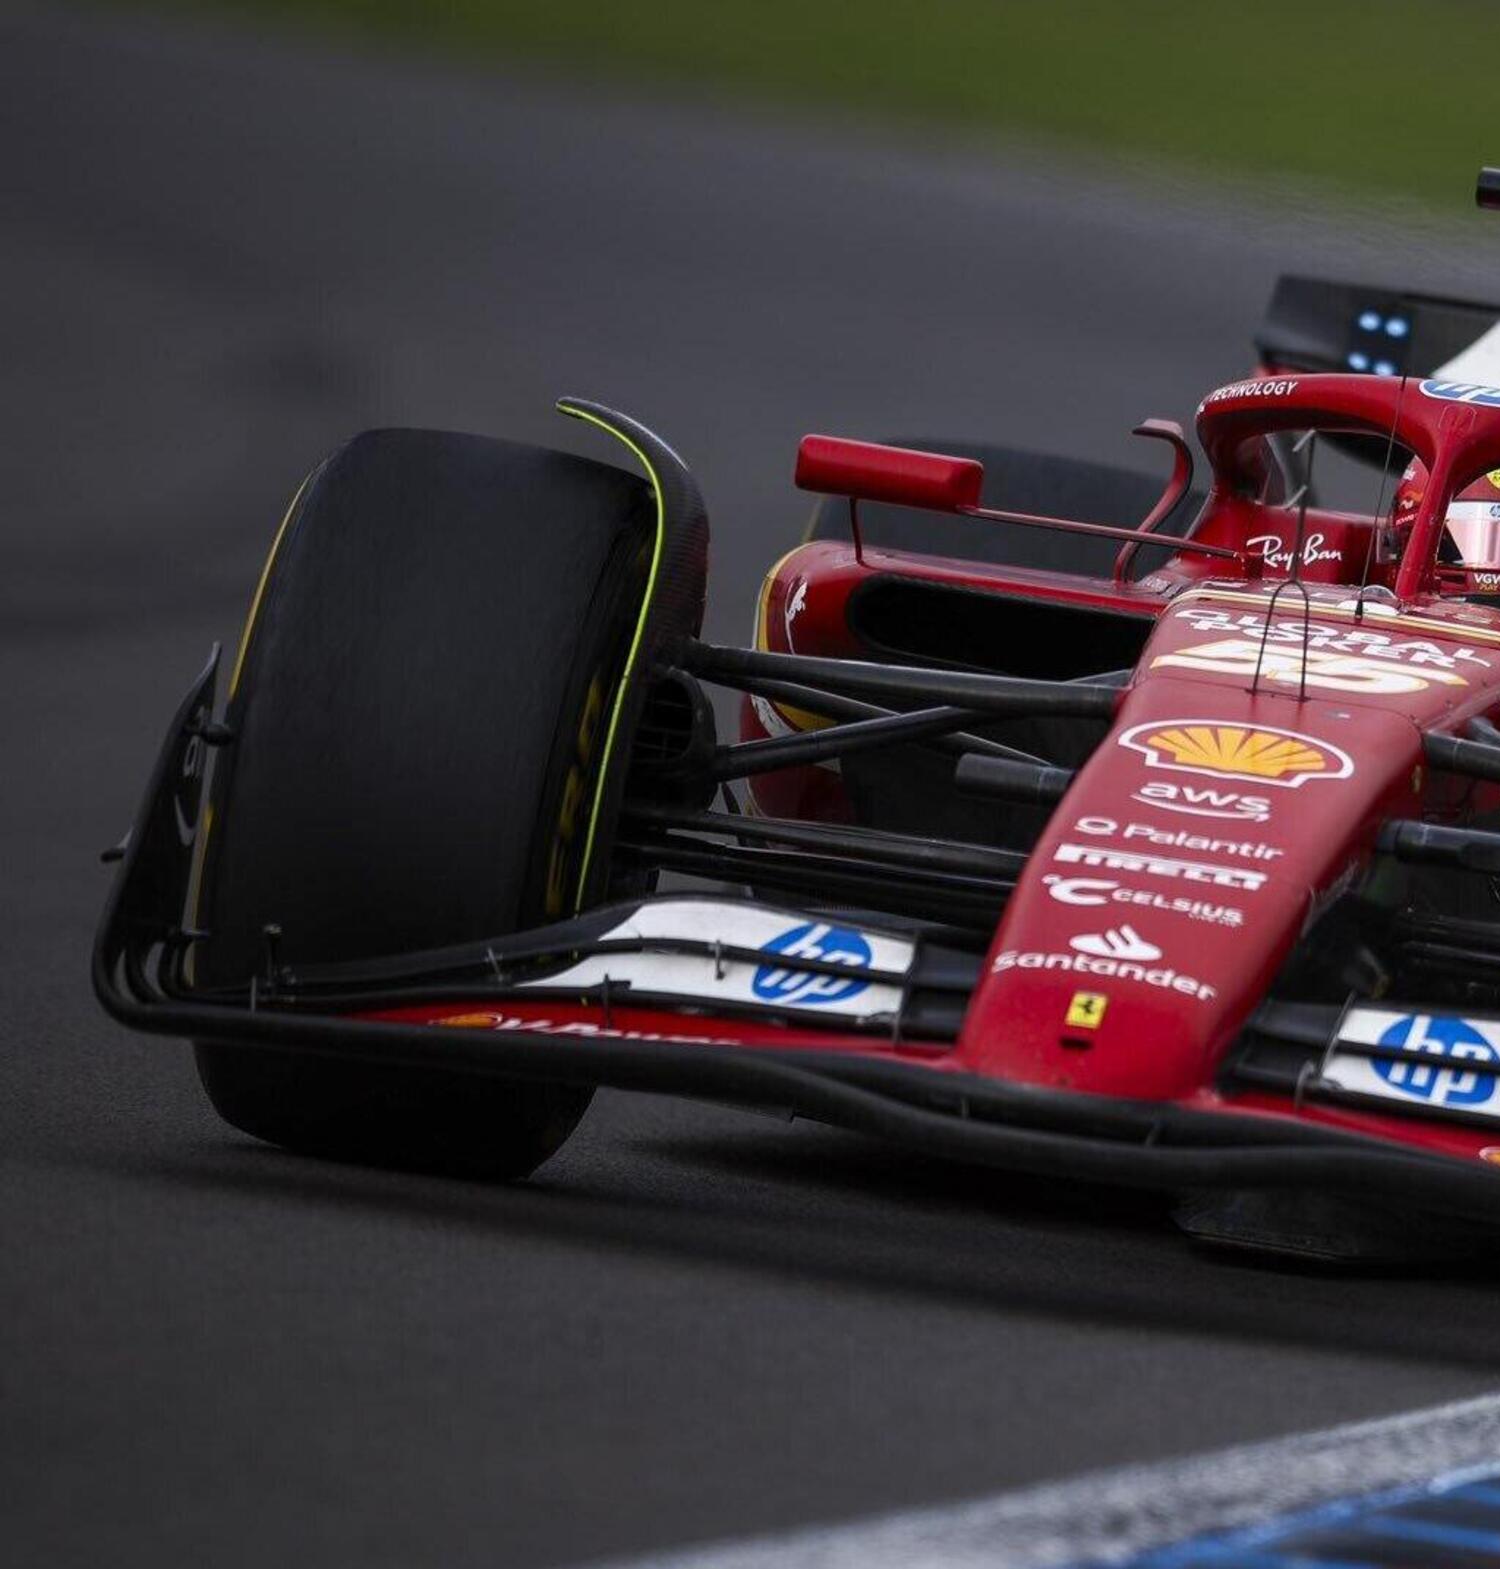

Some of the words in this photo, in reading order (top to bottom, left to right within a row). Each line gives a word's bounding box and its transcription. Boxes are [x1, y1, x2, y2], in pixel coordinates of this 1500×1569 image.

[1246, 533, 1342, 571] Ray-Ban
[1174, 608, 1492, 668] GLOBAL
[1188, 619, 1457, 669] POKER
[1149, 638, 1469, 694] 55
[1140, 782, 1272, 814] aws
[1123, 823, 1284, 860] Palantir
[1053, 843, 1268, 891] PIRELLI
[1111, 887, 1244, 924] CELSIUS
[757, 922, 866, 1004] hp
[991, 950, 1218, 1001] Santander
[1387, 1014, 1493, 1106] hp
